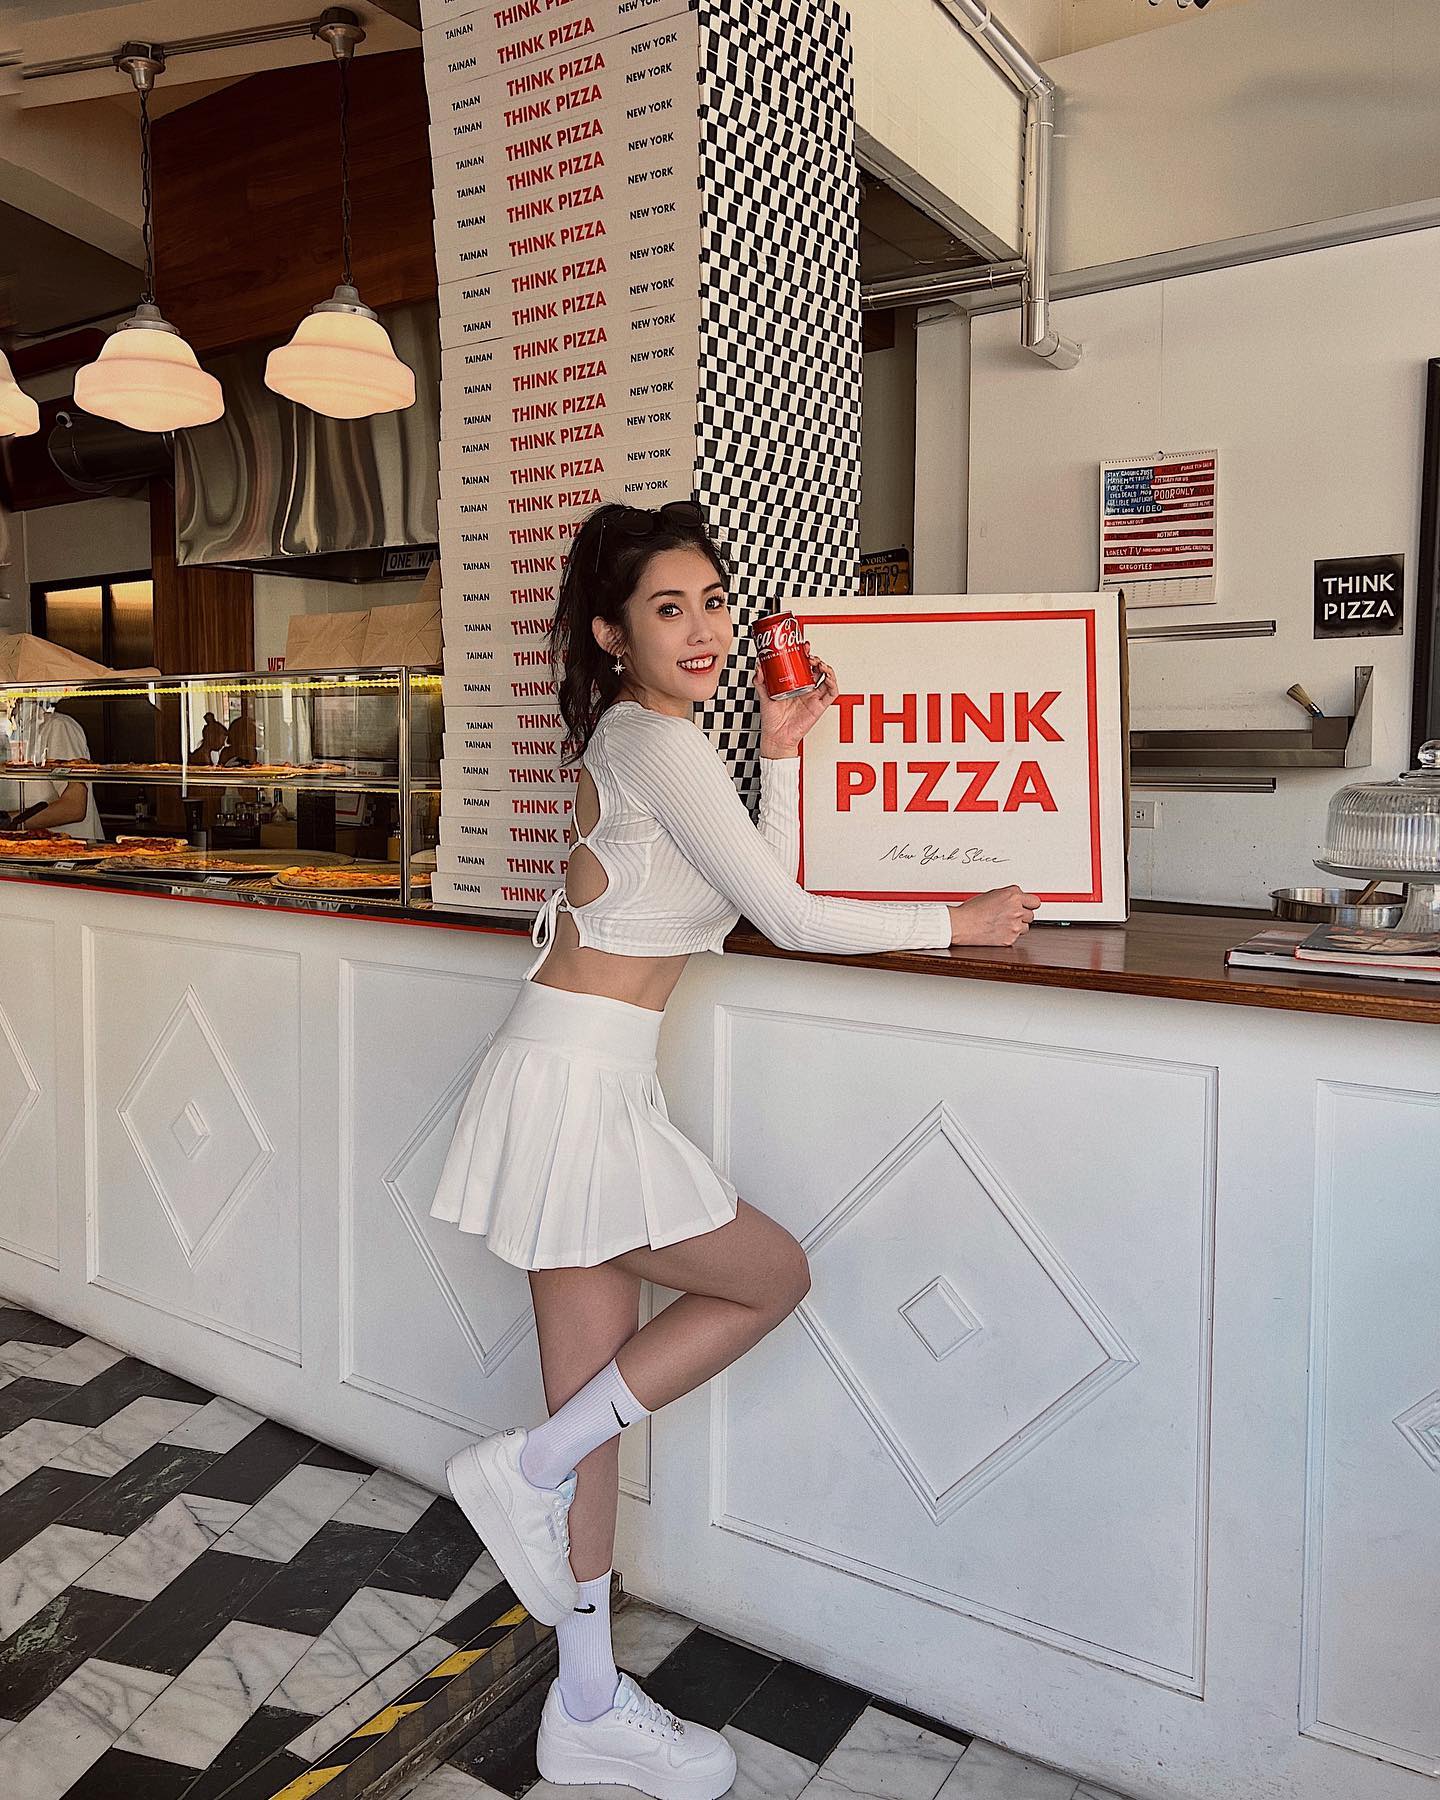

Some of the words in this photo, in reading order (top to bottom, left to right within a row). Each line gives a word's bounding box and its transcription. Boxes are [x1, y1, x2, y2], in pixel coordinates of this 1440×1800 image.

[493, 0, 542, 28] THINK
[618, 0, 639, 14] NEW
[446, 24, 473, 39] TAINAN
[497, 36, 543, 64] THINK
[548, 17, 595, 45] PIZZA
[631, 41, 650, 54] NEW
[652, 32, 677, 45] YORK
[448, 57, 476, 72] TAINAN
[507, 70, 553, 97] THINK
[558, 53, 605, 79] PIZZA
[626, 70, 645, 83] NEW
[647, 62, 672, 75] YORK
[452, 96, 480, 111] TAINAN
[505, 101, 552, 127] THINK
[555, 84, 603, 112] PIZZA
[627, 107, 646, 119] NEW
[648, 99, 672, 111] YORK
[454, 121, 482, 135] TAINAN
[505, 135, 553, 161] THINK
[557, 119, 604, 145] PIZZA
[629, 138, 647, 151] NEW
[650, 132, 674, 145] YORK
[456, 156, 484, 169] TAINAN
[506, 166, 553, 191] THINK
[558, 151, 605, 177] PIZZA
[628, 173, 647, 184] NEW
[650, 167, 673, 179] YORK
[457, 185, 485, 198] TAINAN
[506, 199, 555, 223] THINK
[558, 184, 604, 208] PIZZA
[630, 208, 649, 220] NEW
[651, 202, 675, 214] YORK
[457, 216, 485, 228] TAINAN
[509, 232, 556, 257] THINK
[560, 220, 608, 244] PIZZA
[459, 249, 488, 261] TAINAN
[630, 248, 649, 260] NEW
[651, 242, 675, 254] YORK
[511, 269, 557, 293] THINK
[562, 256, 608, 281] PIZZA
[462, 287, 490, 299] TAINAN
[630, 284, 648, 295] NEW
[651, 278, 674, 290] YORK
[512, 304, 557, 326] THINK
[561, 290, 608, 313] PIZZA
[463, 320, 491, 332] TAINAN
[632, 318, 651, 330] NEW
[653, 313, 675, 324] YORK
[513, 338, 559, 360] THINK
[562, 327, 608, 350] PIZZA
[465, 353, 492, 364] TAINAN
[631, 352, 650, 363] NEW
[652, 347, 674, 358] YORK
[513, 371, 558, 392] THINK
[562, 360, 608, 383] PIZZA
[464, 384, 491, 394] TAINAN
[630, 386, 649, 396] NEW
[651, 381, 673, 391] YORK
[512, 403, 556, 423] THINK
[562, 392, 608, 415] PIZZA
[464, 414, 491, 425] TAINAN
[627, 416, 645, 426] NEW
[648, 412, 671, 422] YORK
[510, 432, 554, 452] THINK
[560, 423, 605, 445] PIZZA
[462, 443, 489, 453] TAINAN
[628, 452, 647, 461] NEW
[649, 448, 671, 457] YORK
[510, 464, 554, 485] THINK
[559, 457, 604, 479] PIZZA
[462, 476, 489, 485] TAINAN
[625, 483, 644, 492] NEW
[646, 480, 667, 489] YORK
[508, 496, 553, 513] THINK
[557, 488, 603, 508] PIZZA
[1154, 489, 1175, 500] POOR
[1175, 487, 1194, 496] ONLY
[460, 504, 487, 513] TAINAN
[1137, 505, 1162, 513] VIDEO
[461, 533, 488, 542] TAINAN
[509, 526, 554, 544] THINK
[1129, 546, 1142, 556] TV
[390, 552, 412, 569] ONE
[463, 562, 490, 570] TAINAN
[511, 557, 556, 574] THINK
[865, 555, 888, 565] YORK
[1323, 573, 1394, 594] THINK
[463, 593, 489, 601] TAINAN
[510, 586, 555, 604] THINK
[1324, 600, 1395, 620] PIZZA
[464, 684, 490, 692] TAINAN
[511, 681, 555, 697] THINK
[517, 714, 561, 728] THINK
[831, 691, 1065, 743] THINK
[512, 741, 556, 754] THINK
[463, 767, 488, 775] TAINAN
[509, 769, 555, 783] THINK
[836, 761, 1058, 812] PIZZA
[464, 798, 489, 807] TAINAN
[512, 800, 558, 814] THINK
[461, 826, 487, 835] TAINAN
[510, 828, 558, 843] THINK
[458, 856, 484, 865] TAINAN
[880, 844, 916, 861] New
[920, 845, 959, 865] York
[962, 848, 1009, 864] Slice
[507, 858, 555, 874] THINK
[454, 883, 480, 893] TAINAN
[501, 887, 546, 902] THINK
